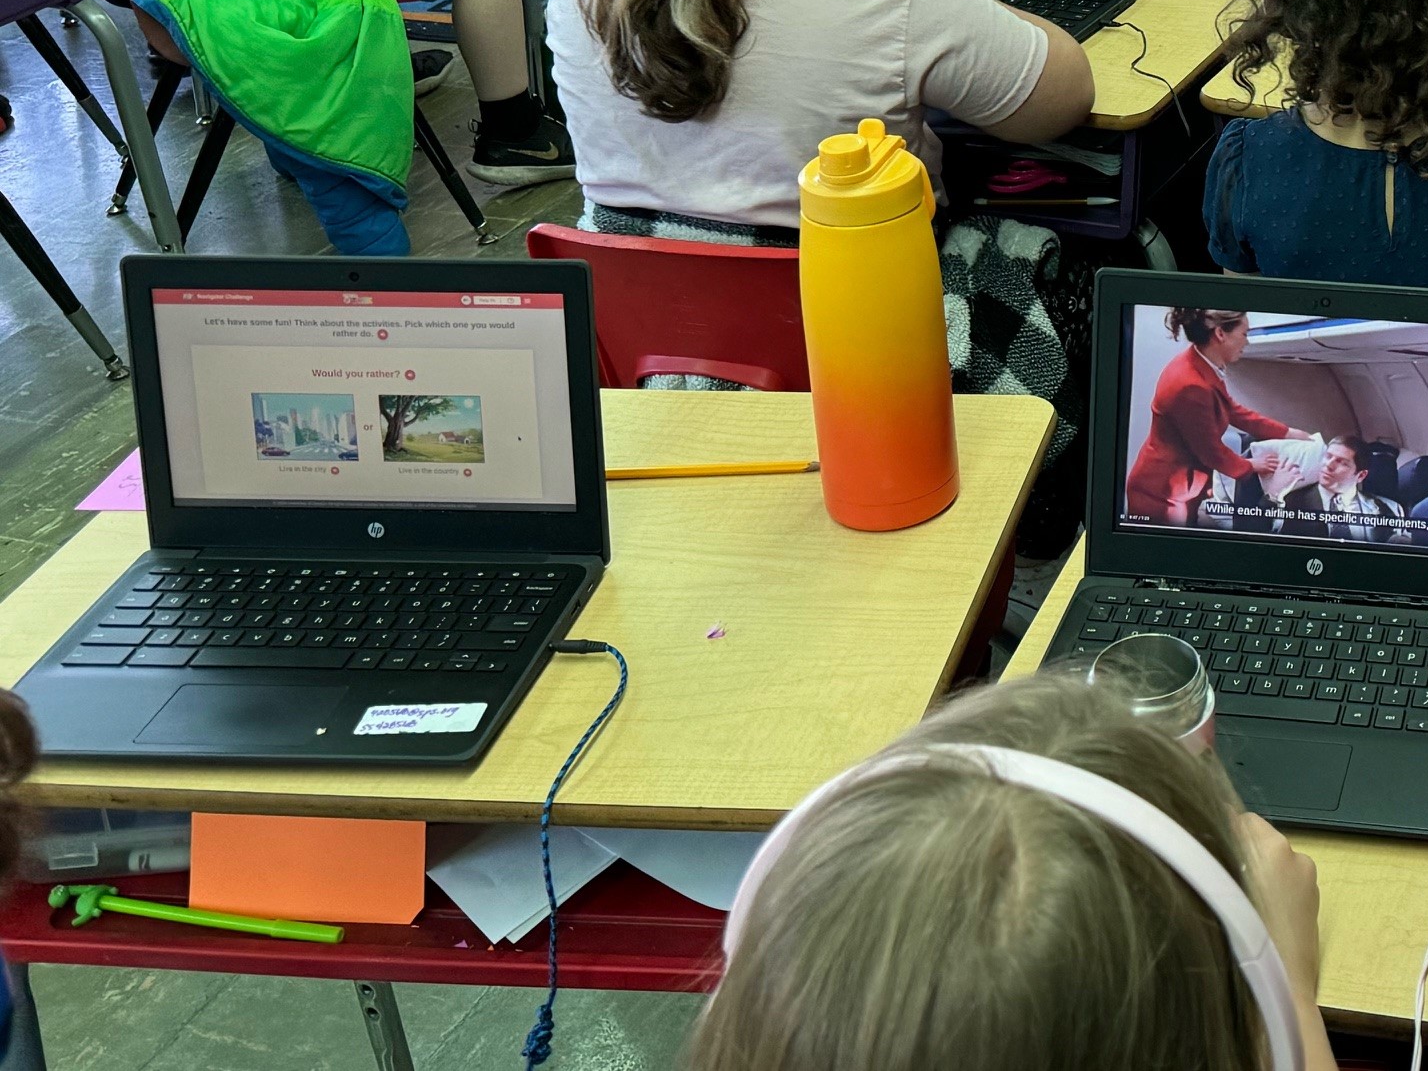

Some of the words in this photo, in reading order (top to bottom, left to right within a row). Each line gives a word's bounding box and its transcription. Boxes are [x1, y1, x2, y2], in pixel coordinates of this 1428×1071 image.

[312, 369, 343, 378] Would
[345, 371, 364, 380] you
[366, 370, 400, 379] rather?
[1206, 503, 1234, 514] While
[1237, 508, 1262, 516] each
[1264, 509, 1295, 519] airline
[1297, 511, 1317, 520] has
[1318, 512, 1357, 526] specific
